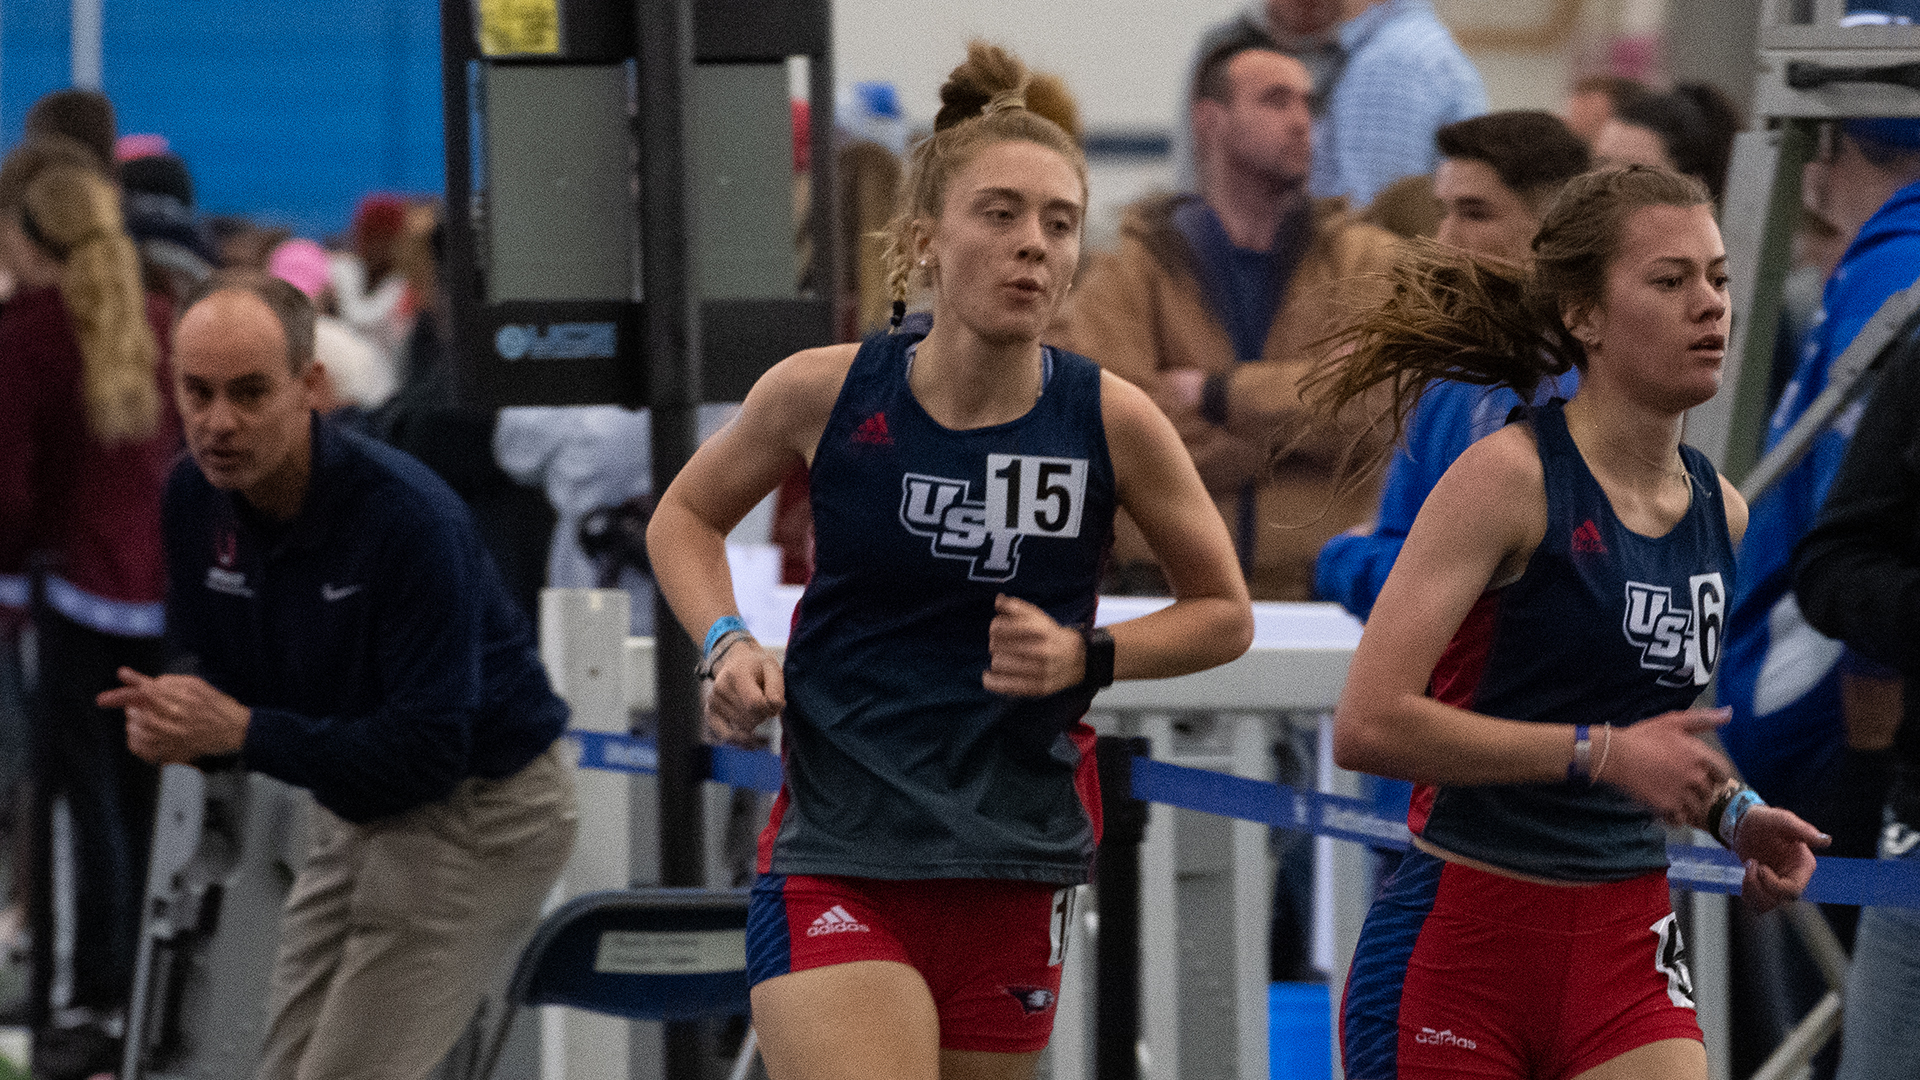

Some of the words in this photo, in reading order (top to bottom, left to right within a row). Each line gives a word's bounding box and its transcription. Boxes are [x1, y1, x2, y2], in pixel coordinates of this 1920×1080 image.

[994, 459, 1072, 532] 15
[1698, 581, 1720, 675] 6
[806, 922, 870, 937] adidas
